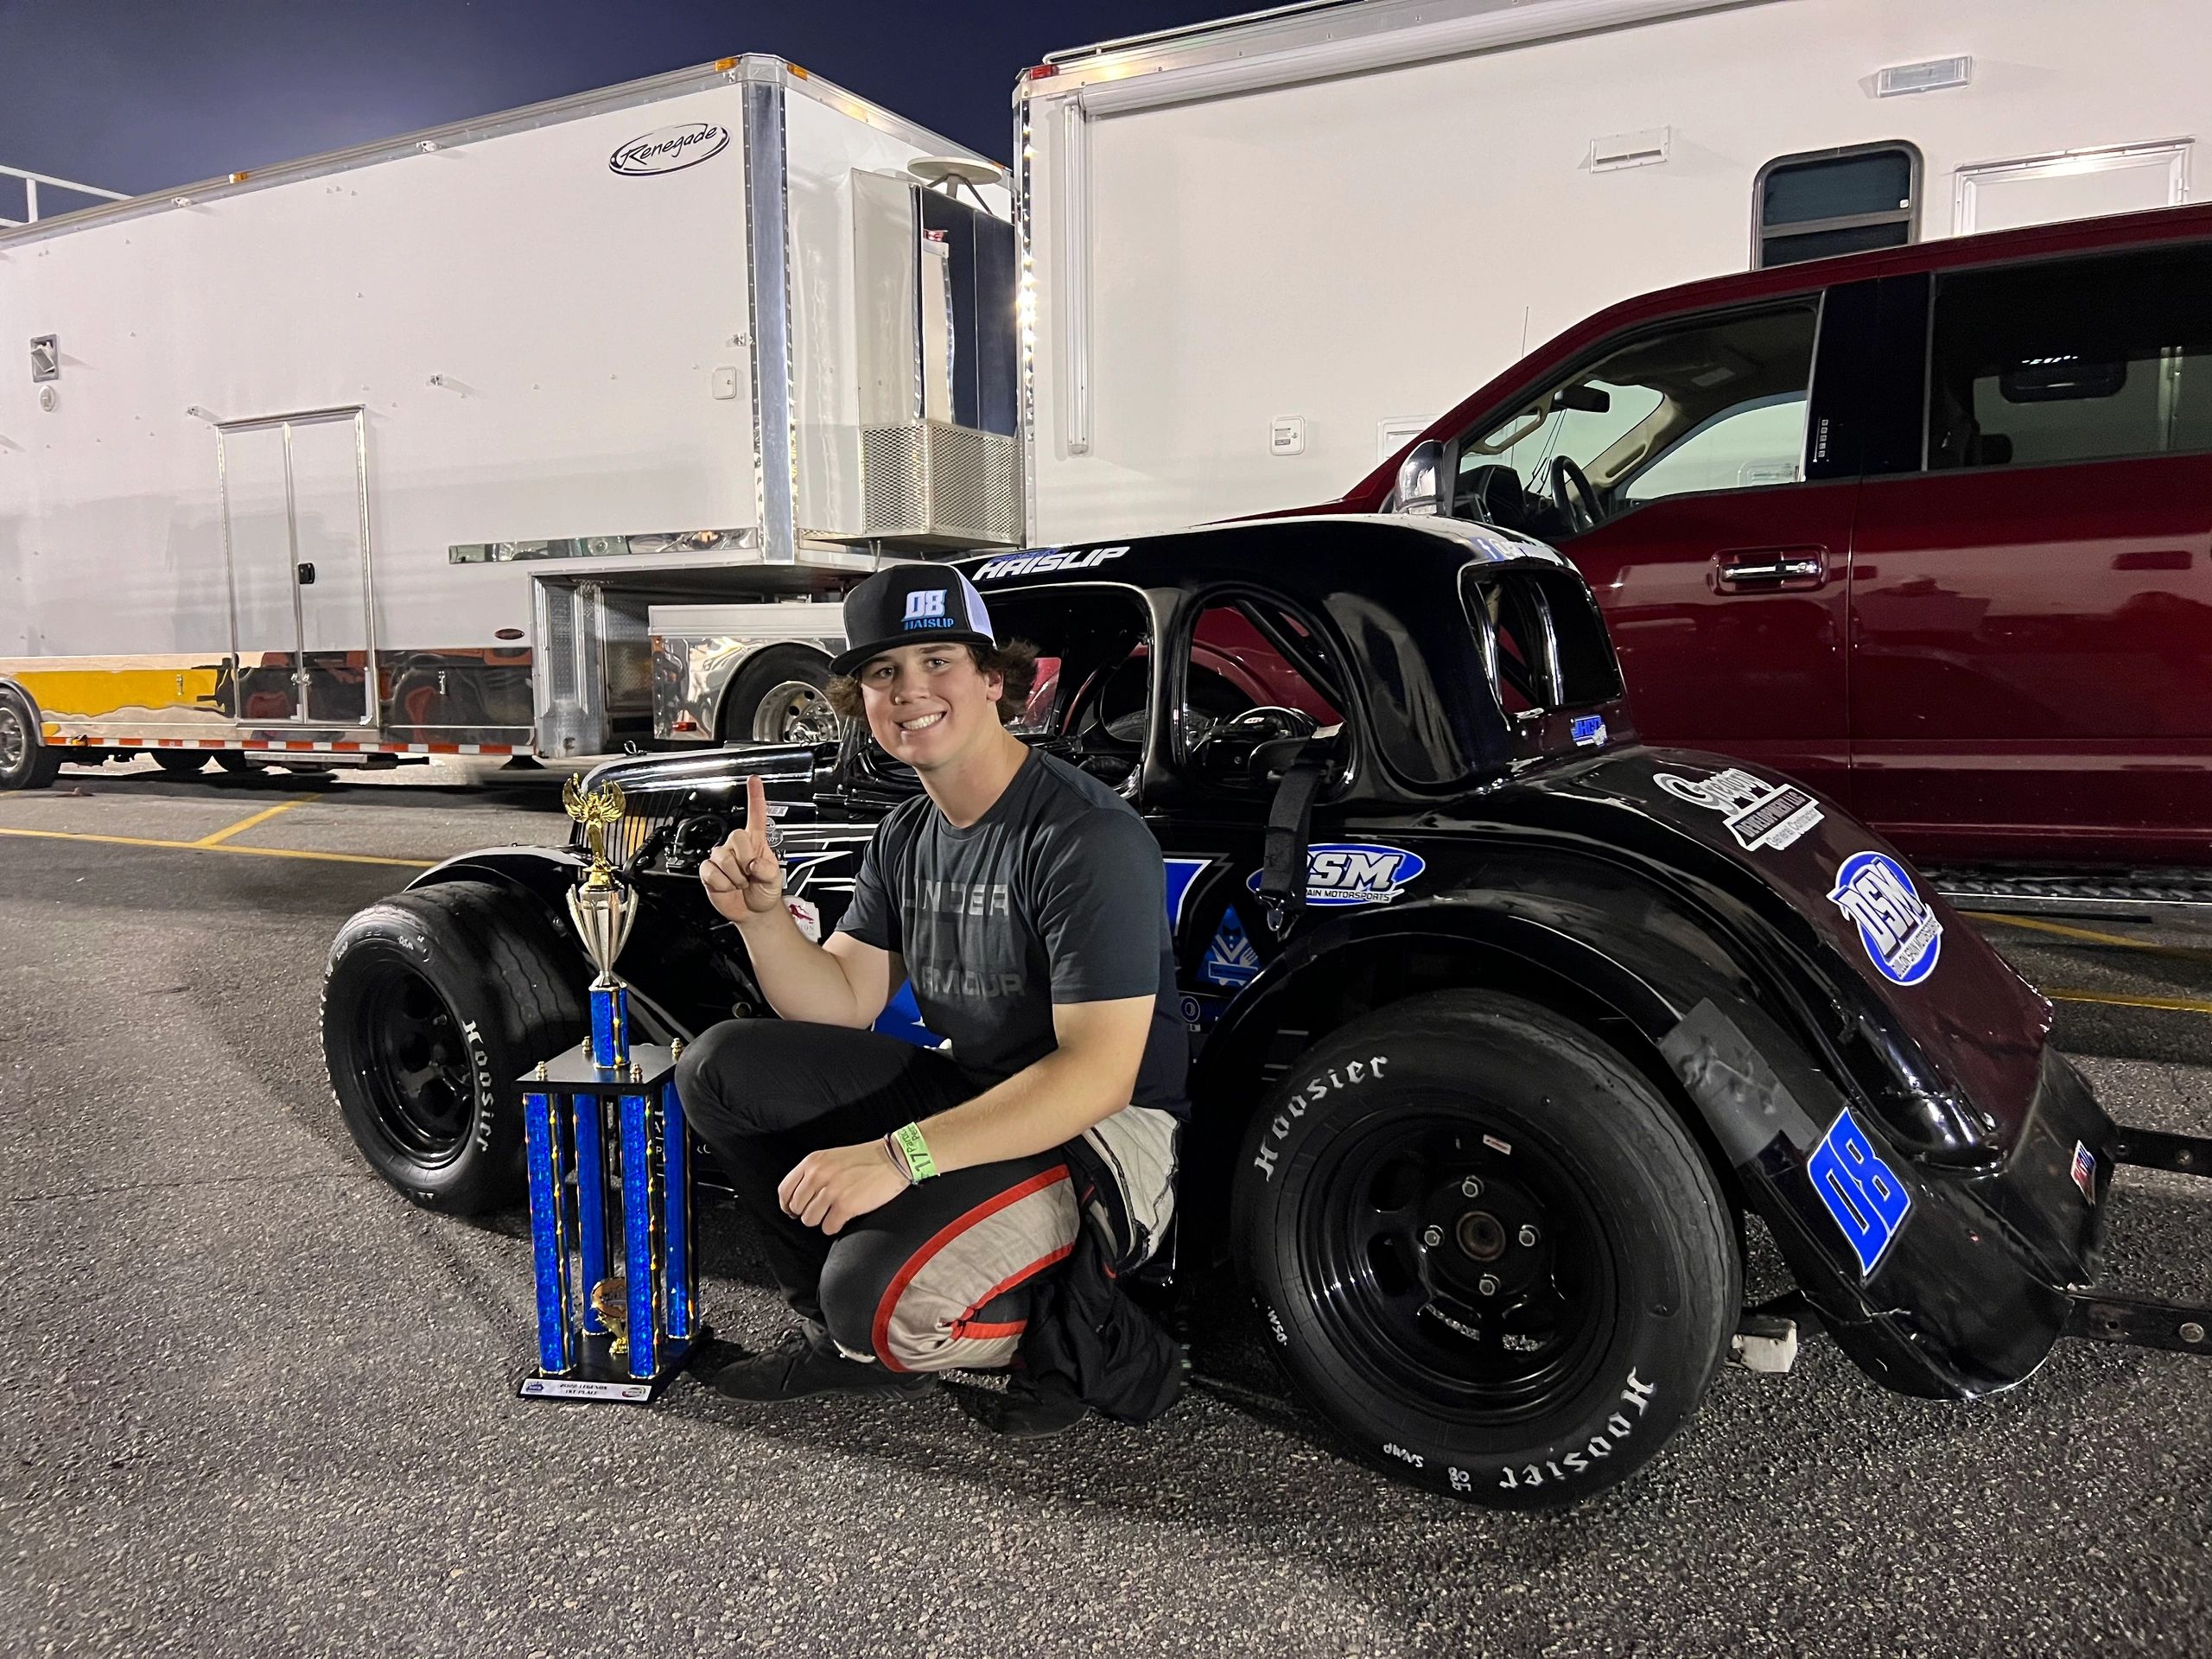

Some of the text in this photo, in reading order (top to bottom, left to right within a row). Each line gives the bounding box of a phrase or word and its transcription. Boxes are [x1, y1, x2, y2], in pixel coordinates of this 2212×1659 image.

[620, 124, 717, 168] Renegade
[972, 547, 1130, 581] HAISLIP
[902, 589, 948, 621] 08
[904, 618, 954, 630] HAISLIP
[766, 806, 785, 815] NEX
[1734, 795, 1795, 838] DEVELOPMENT
[1307, 853, 1401, 889] SM
[1324, 891, 1390, 902] MOTORSPORTS
[1834, 856, 1926, 958] DSM
[461, 1019, 494, 1153] Hoosier
[1254, 1057, 1388, 1182] Hoosier
[1807, 1106, 1912, 1277] 08
[1499, 1366, 1656, 1490] Hoosier
